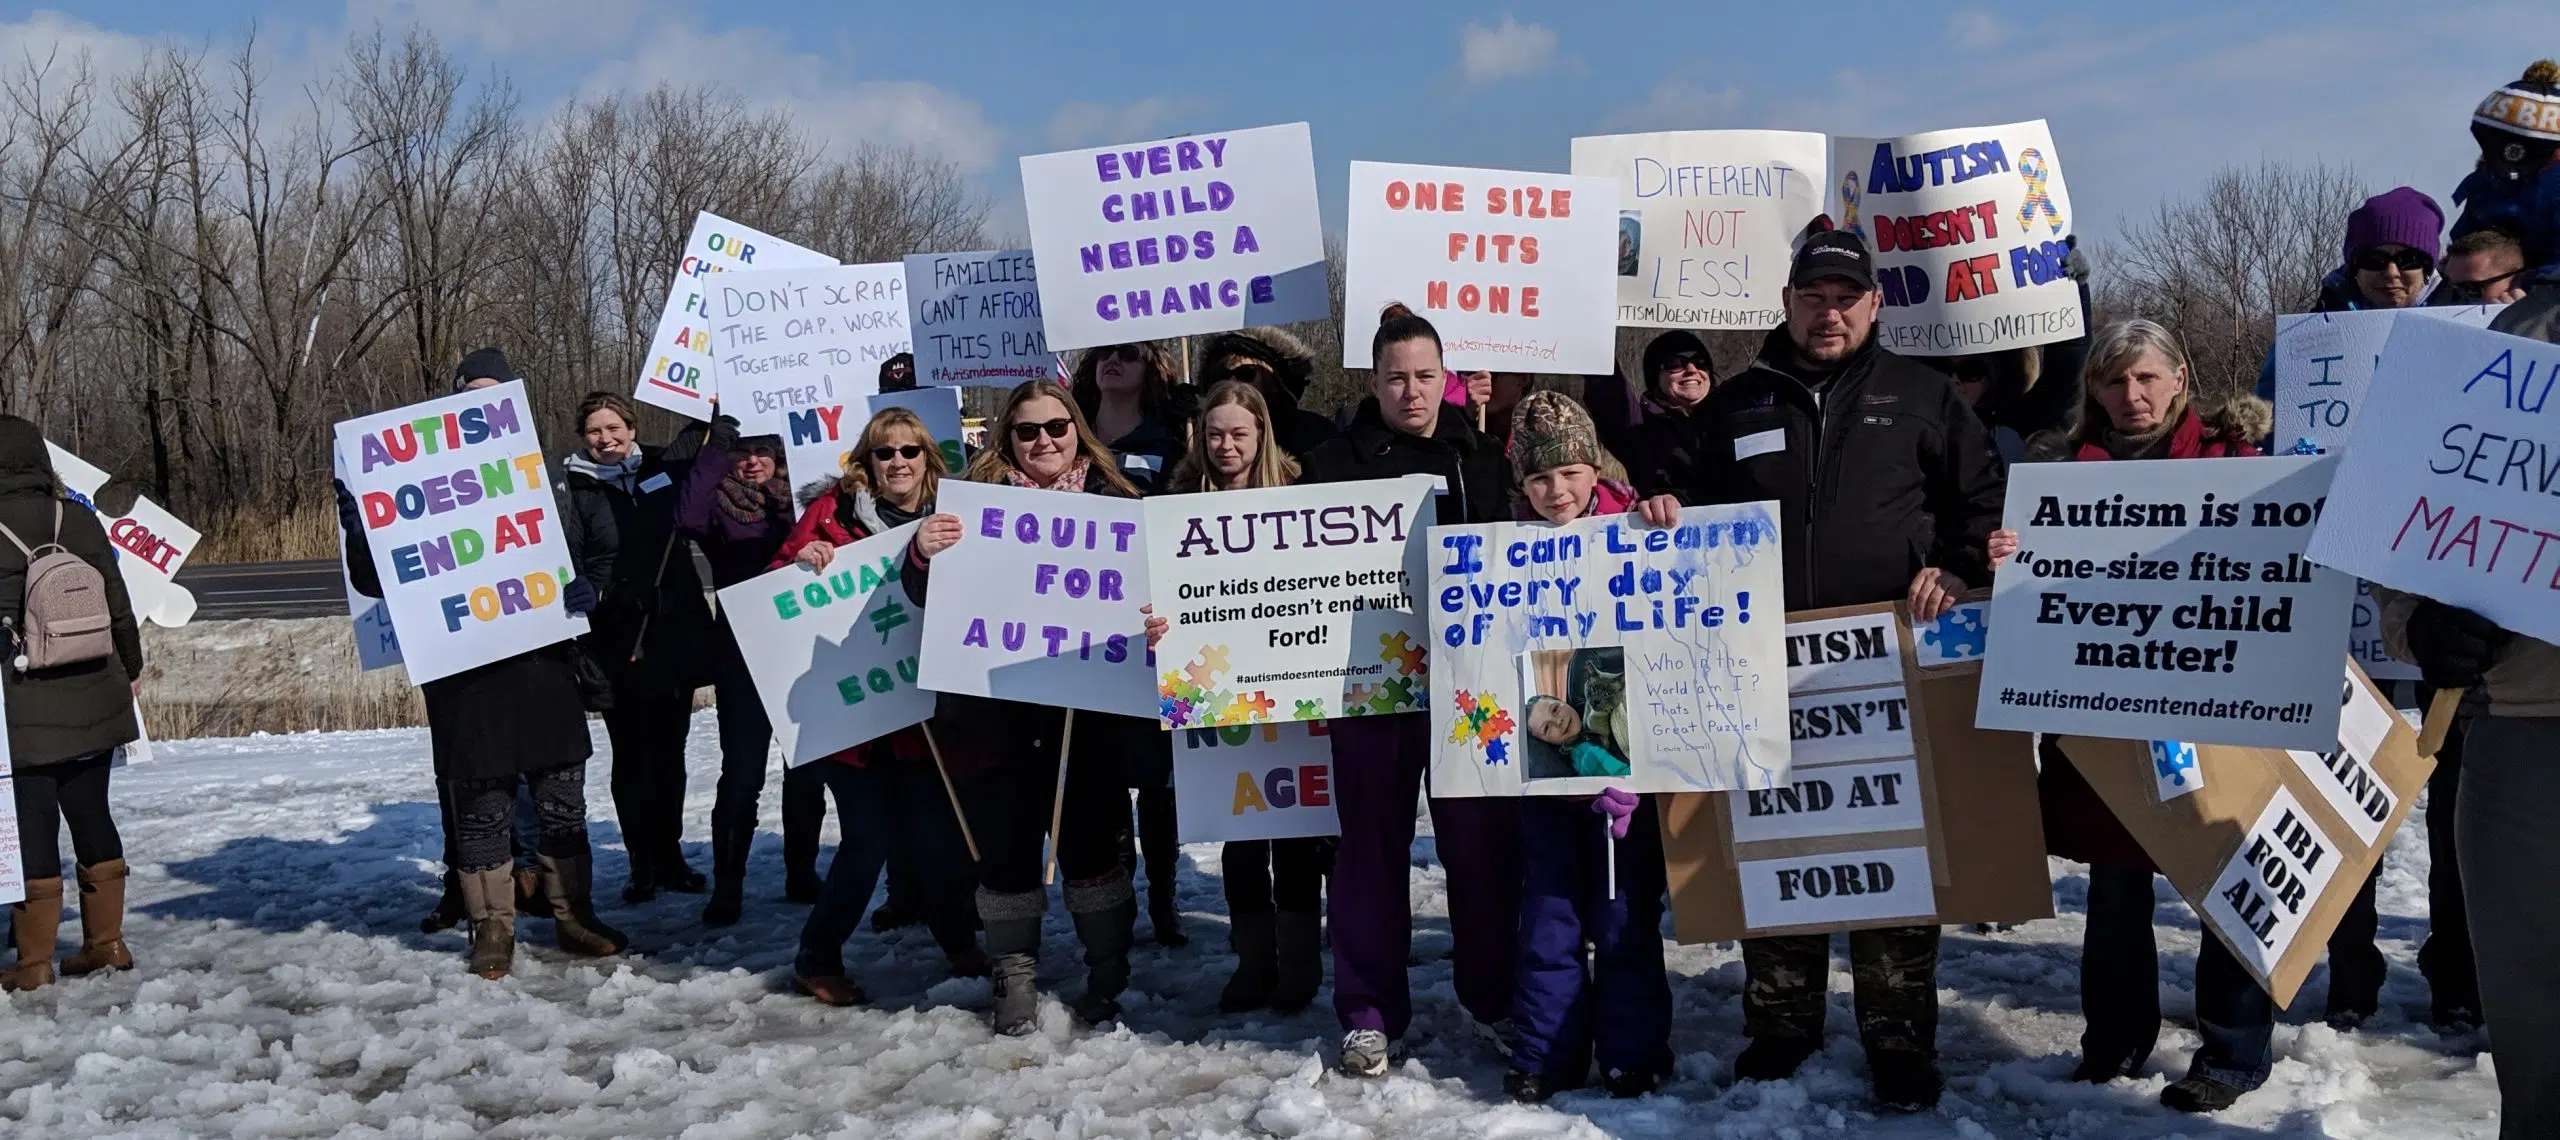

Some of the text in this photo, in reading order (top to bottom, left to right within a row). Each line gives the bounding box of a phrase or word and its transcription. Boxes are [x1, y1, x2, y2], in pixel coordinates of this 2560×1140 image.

[1096, 138, 1227, 182] EVERY
[1635, 157, 1793, 200] DIFFERENT
[1867, 139, 2011, 194] AUTISM
[1102, 181, 1235, 223] CHILD
[1386, 180, 1571, 218] ONE SIZE
[1683, 209, 1746, 249] NOT
[1873, 200, 1998, 253] DOESN'T
[708, 233, 756, 264] OUR
[1080, 225, 1260, 274] NEEDS A
[1448, 232, 1539, 264] FITS
[935, 257, 1037, 289] FAMILIES
[1653, 254, 1750, 299] LESS!
[1877, 265, 1931, 309] ND
[1944, 253, 2000, 303] AT
[724, 278, 902, 317] DON'T SCRAP
[920, 294, 968, 326] CAN'T
[1096, 275, 1275, 321] CHANCE
[1426, 280, 1540, 317] NONE
[674, 327, 714, 356] AR
[720, 310, 904, 348] THE OAP. WORK
[930, 334, 992, 362] THIS
[654, 356, 700, 389] FOR
[725, 352, 809, 376] TOGETHER
[818, 348, 851, 366] TO
[2308, 355, 2344, 387] I
[788, 404, 843, 446] MY
[2298, 399, 2349, 428] TO
[362, 398, 520, 474] AUTISM
[2429, 423, 2560, 497] SERV
[980, 507, 1136, 552] EQUIT
[2030, 493, 2187, 527] Autism
[2199, 492, 2239, 527] is
[110, 518, 182, 571] CAN'T
[391, 508, 544, 584] END AT
[1176, 503, 1406, 558] AUTISM
[1443, 519, 1760, 575] I can Learn
[1035, 563, 1124, 601] FOR
[1178, 568, 1410, 600] Our kids deserve better,
[1608, 561, 1699, 597] day
[2188, 551, 2251, 582] fits
[2261, 553, 2323, 583] all
[1179, 591, 1413, 625] autism doesn't end with
[1529, 611, 1597, 638] my
[2036, 592, 2293, 637] Every child
[963, 618, 1156, 668] AUTIS
[1268, 625, 1328, 648] Ford!
[1786, 626, 1889, 668] TISM
[2075, 639, 2239, 673] matter!
[836, 655, 918, 706] EQU
[1236, 664, 1383, 684] #autismdoesntendatford!!
[1644, 652, 1684, 672] Who
[1716, 649, 1748, 669] the
[1646, 681, 1688, 696] World
[1697, 684, 1722, 694] am
[1648, 700, 1736, 716] Thats the
[2000, 687, 2313, 724] #autismdoesntendatford!!
[1652, 721, 1698, 736] Great
[1790, 698, 1908, 741] ESN'T
[1232, 765, 1330, 816] AGE
[1749, 773, 1903, 817] END AT
[2316, 740, 2390, 822] IND
[2273, 807, 2325, 875] IBI
[1776, 861, 1895, 901] FORD
[2244, 834, 2307, 915] FOR
[2222, 877, 2280, 950] ALL
